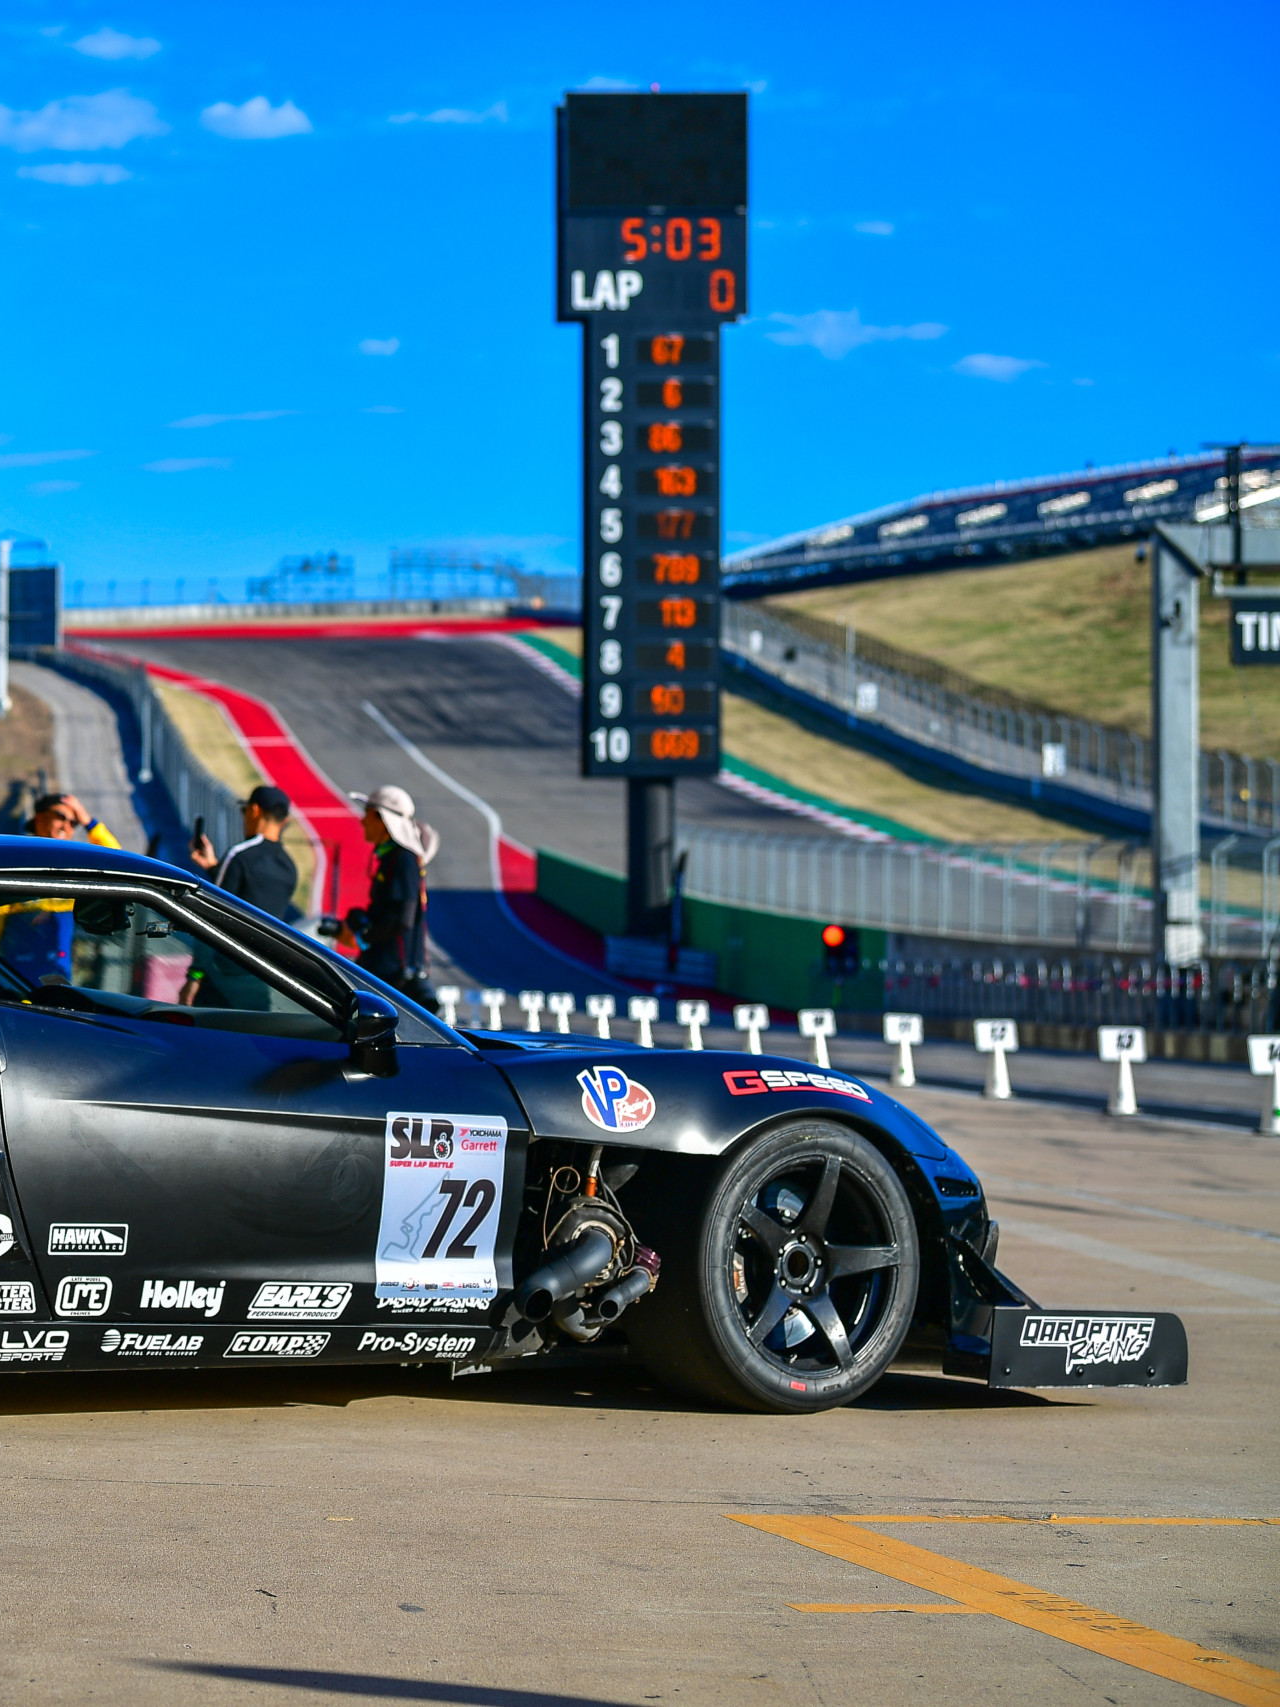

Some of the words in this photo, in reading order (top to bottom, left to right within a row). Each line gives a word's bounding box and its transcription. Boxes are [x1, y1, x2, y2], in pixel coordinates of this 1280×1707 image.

[620, 217, 721, 261] 5:03
[570, 269, 644, 311] LAP
[708, 268, 736, 312] 0
[600, 332, 620, 369] 1
[599, 376, 623, 412] 2
[599, 419, 623, 456] 3
[598, 463, 623, 500] 4
[599, 507, 623, 544] 5
[598, 551, 623, 588] 6
[599, 594, 623, 631] 7
[599, 638, 623, 675] 8
[599, 682, 623, 719] 9
[588, 726, 631, 763] 10
[581, 1070, 628, 1128] VP
[722, 1070, 869, 1100] GSPEED
[391, 1117, 455, 1160] SLB
[461, 1139, 498, 1151] Garrett
[469, 1129, 502, 1138] YOKOHAMA
[389, 1160, 413, 1168] SUPER
[429, 1161, 455, 1169] BATTLE
[52, 1228, 103, 1244] HAWK
[421, 1178, 497, 1259] 72
[140, 1280, 226, 1318] Holley
[253, 1286, 348, 1308] EARL'S
[120, 1333, 204, 1351] FUELAB
[231, 1335, 305, 1352] COMP
[357, 1332, 476, 1355] Pro-System
